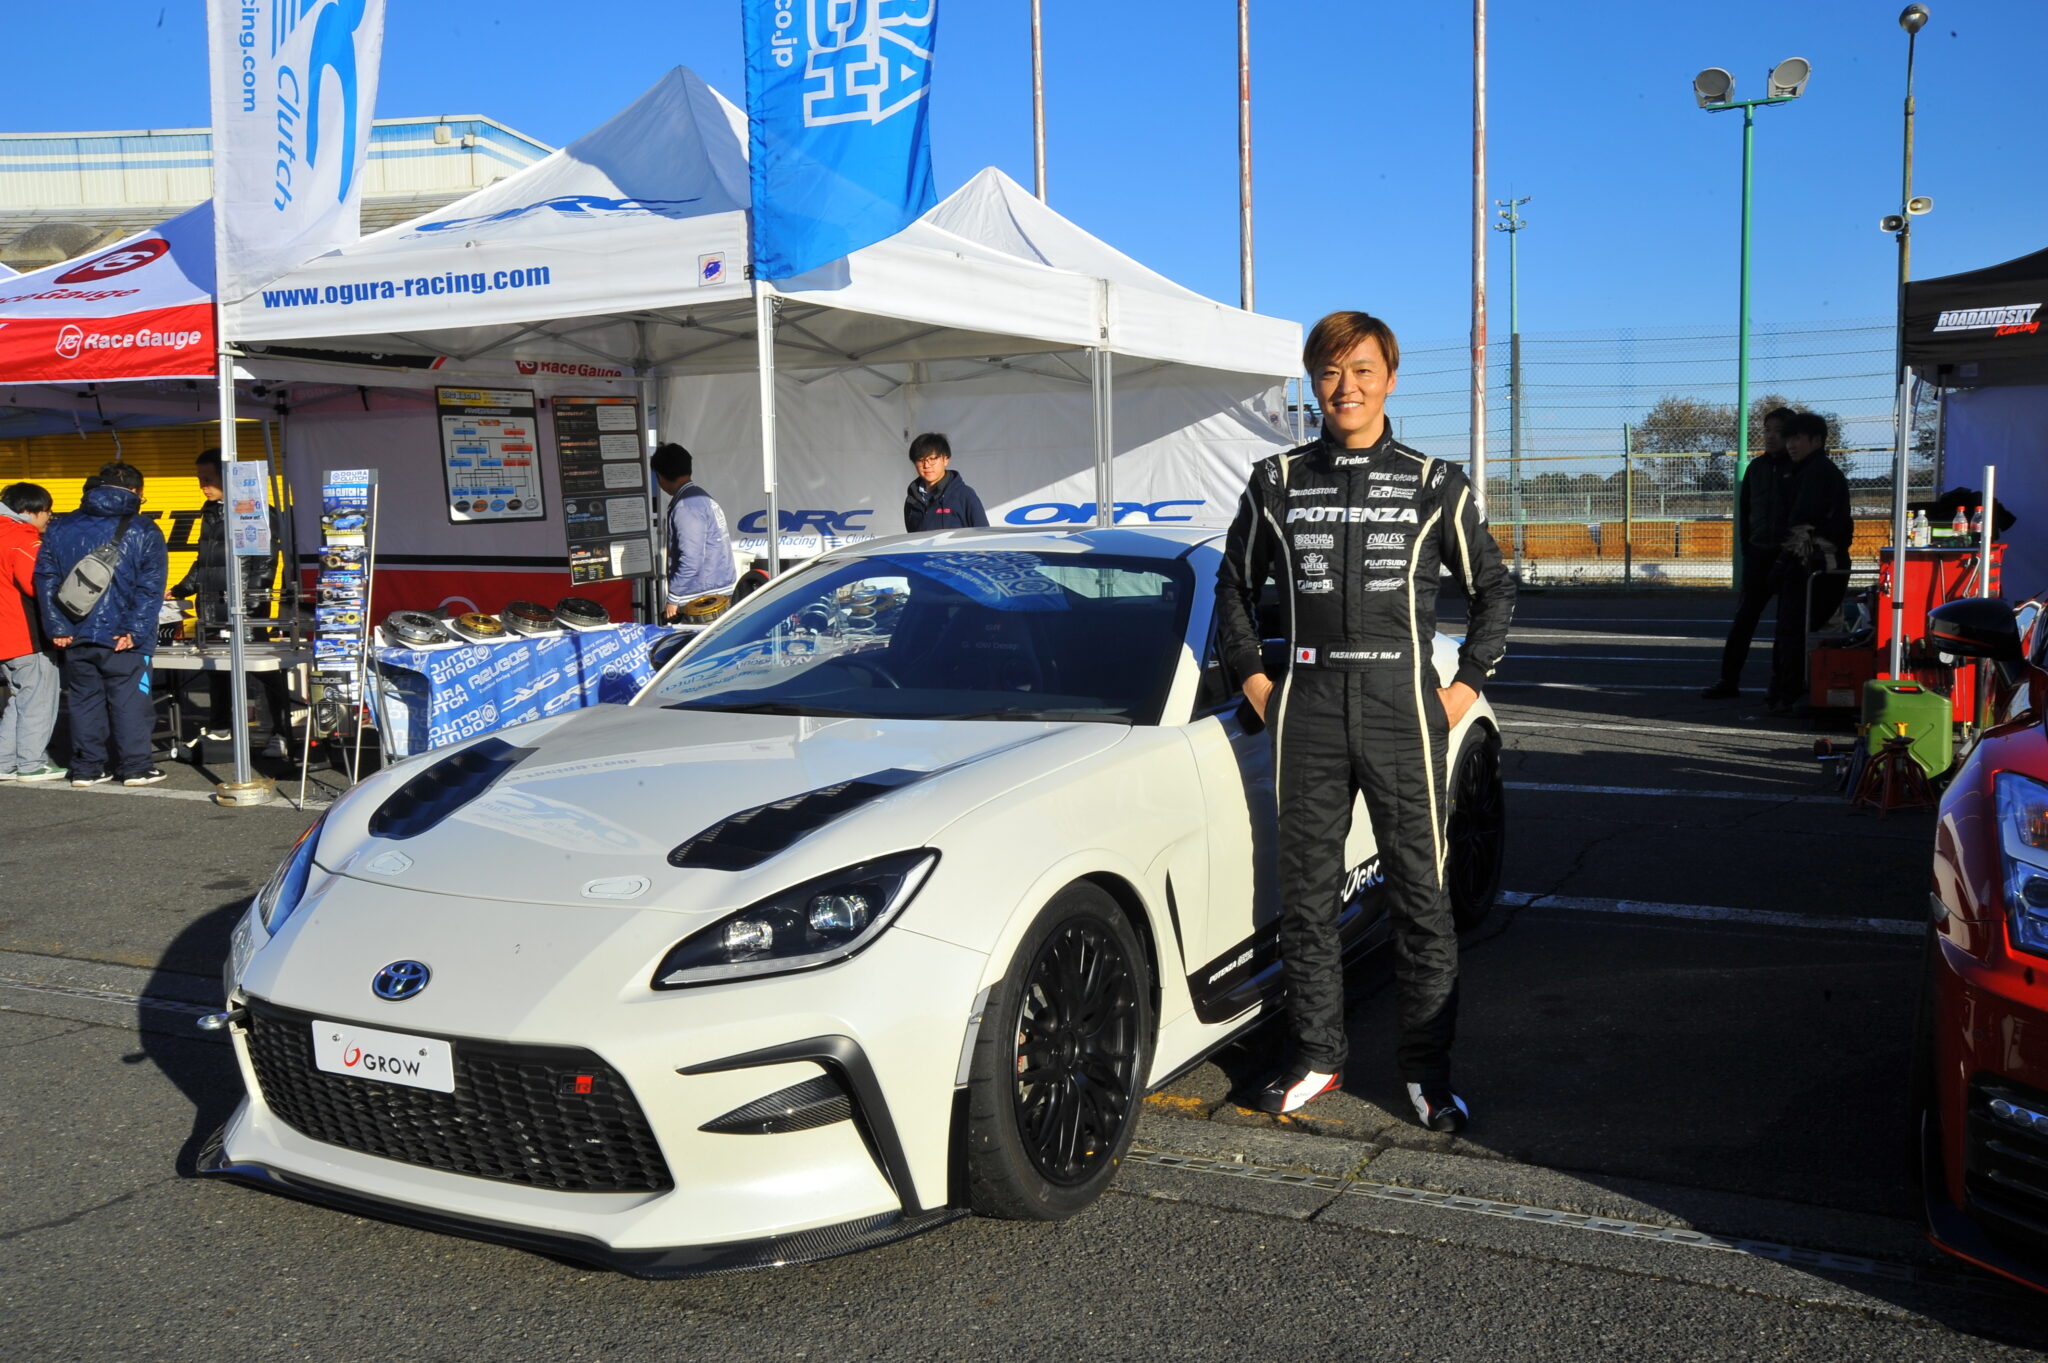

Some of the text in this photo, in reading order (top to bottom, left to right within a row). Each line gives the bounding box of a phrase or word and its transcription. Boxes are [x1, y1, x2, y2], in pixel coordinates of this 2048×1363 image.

[274, 65, 300, 211] Clutch
[262, 264, 550, 309] www.ogura-racing.com
[1937, 309, 2037, 327] ROADANDSKY
[1994, 321, 2040, 338] Racing
[84, 329, 202, 350] RaceGauge
[1289, 487, 1339, 497] BRIDGESTONE
[737, 510, 874, 536] ORC
[1286, 506, 1418, 524] POTENZA
[779, 535, 817, 547] Racing
[1367, 533, 1406, 544] ENDLESS
[363, 1053, 420, 1077] GROW
